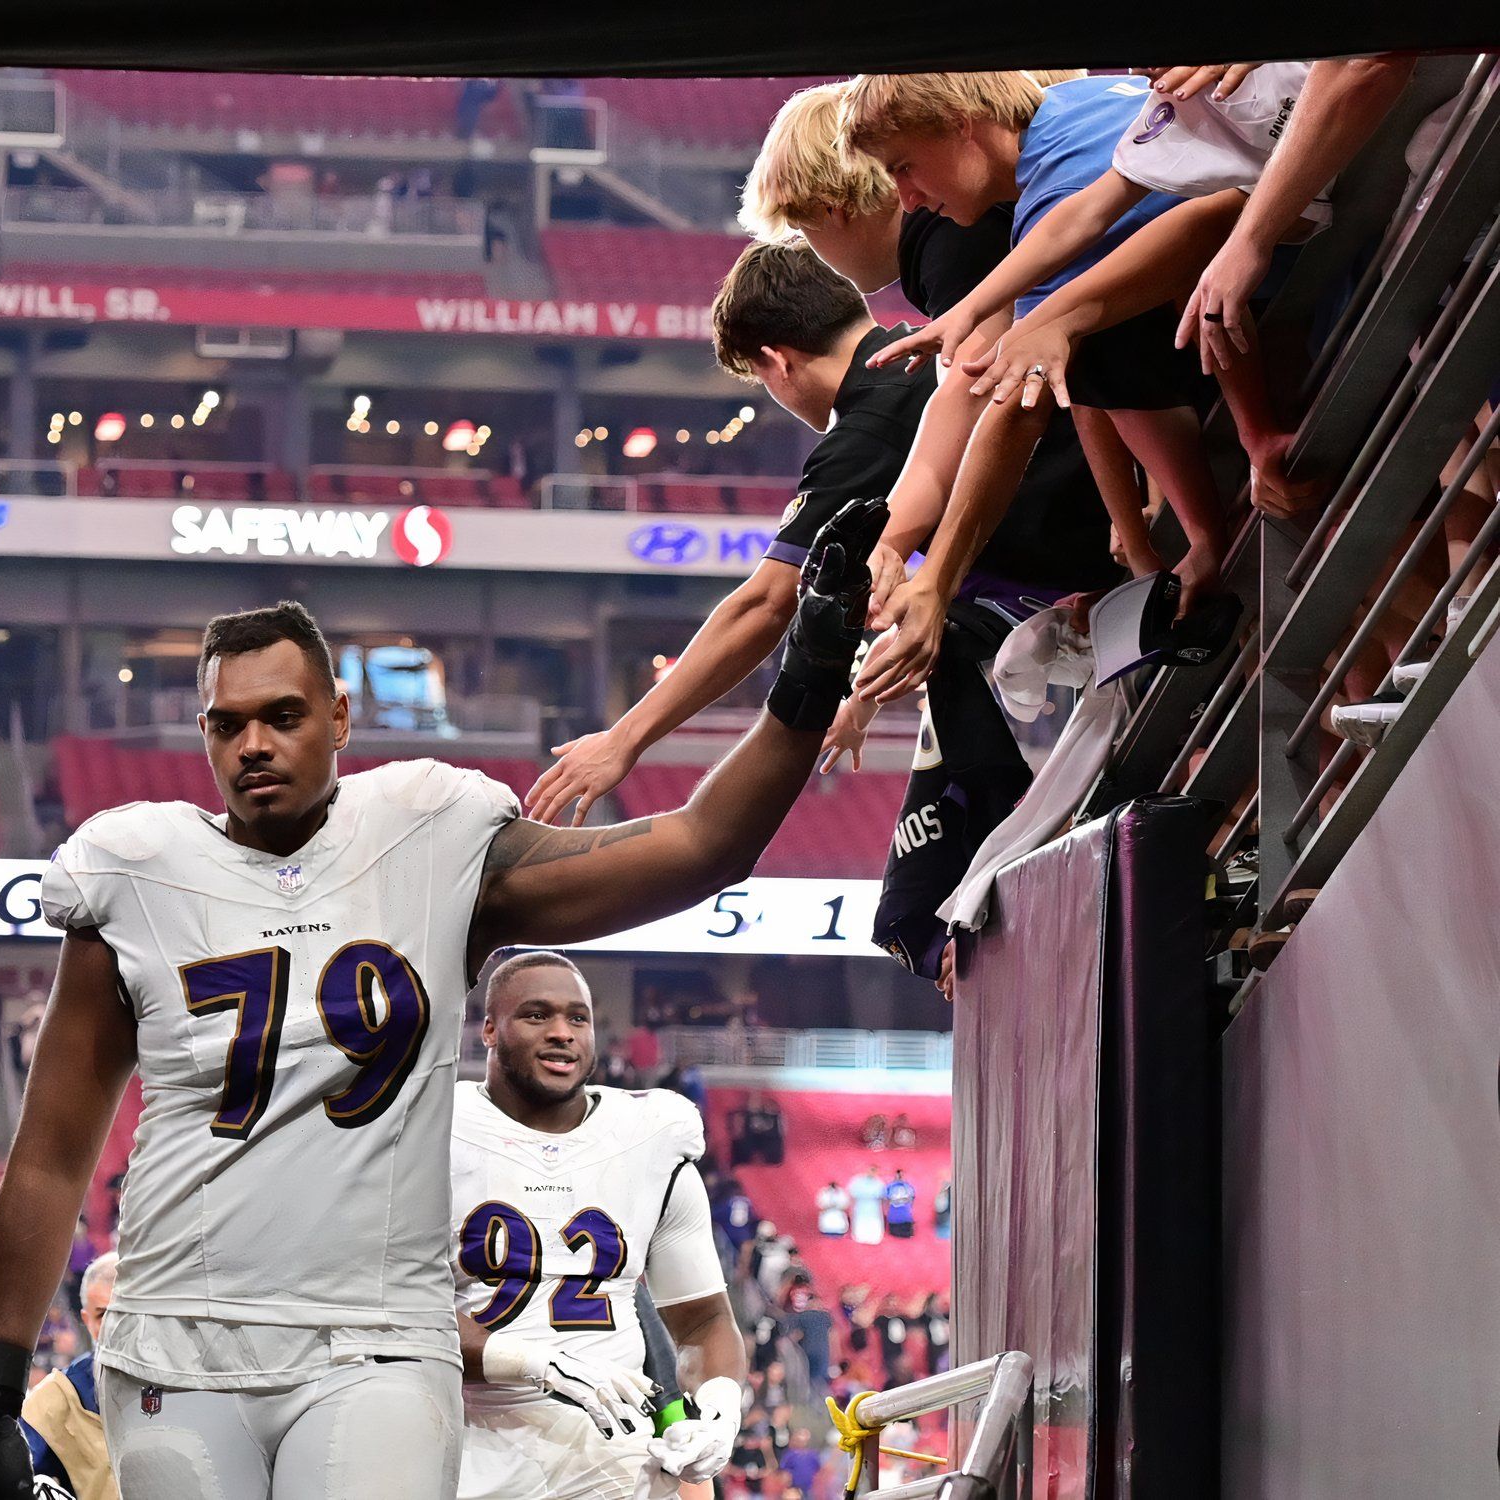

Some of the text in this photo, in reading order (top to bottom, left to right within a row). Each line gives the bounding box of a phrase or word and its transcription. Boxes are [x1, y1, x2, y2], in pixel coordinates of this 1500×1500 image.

[1133, 101, 1175, 144] 9
[104, 287, 171, 322] SR.
[415, 300, 598, 334] WILLIAM
[607, 303, 648, 336] V.
[171, 505, 389, 558] SAFEWAY
[259, 922, 332, 938] RAVENS
[811, 895, 846, 940] 1
[178, 939, 430, 1141] 79
[458, 1200, 628, 1332] 92
